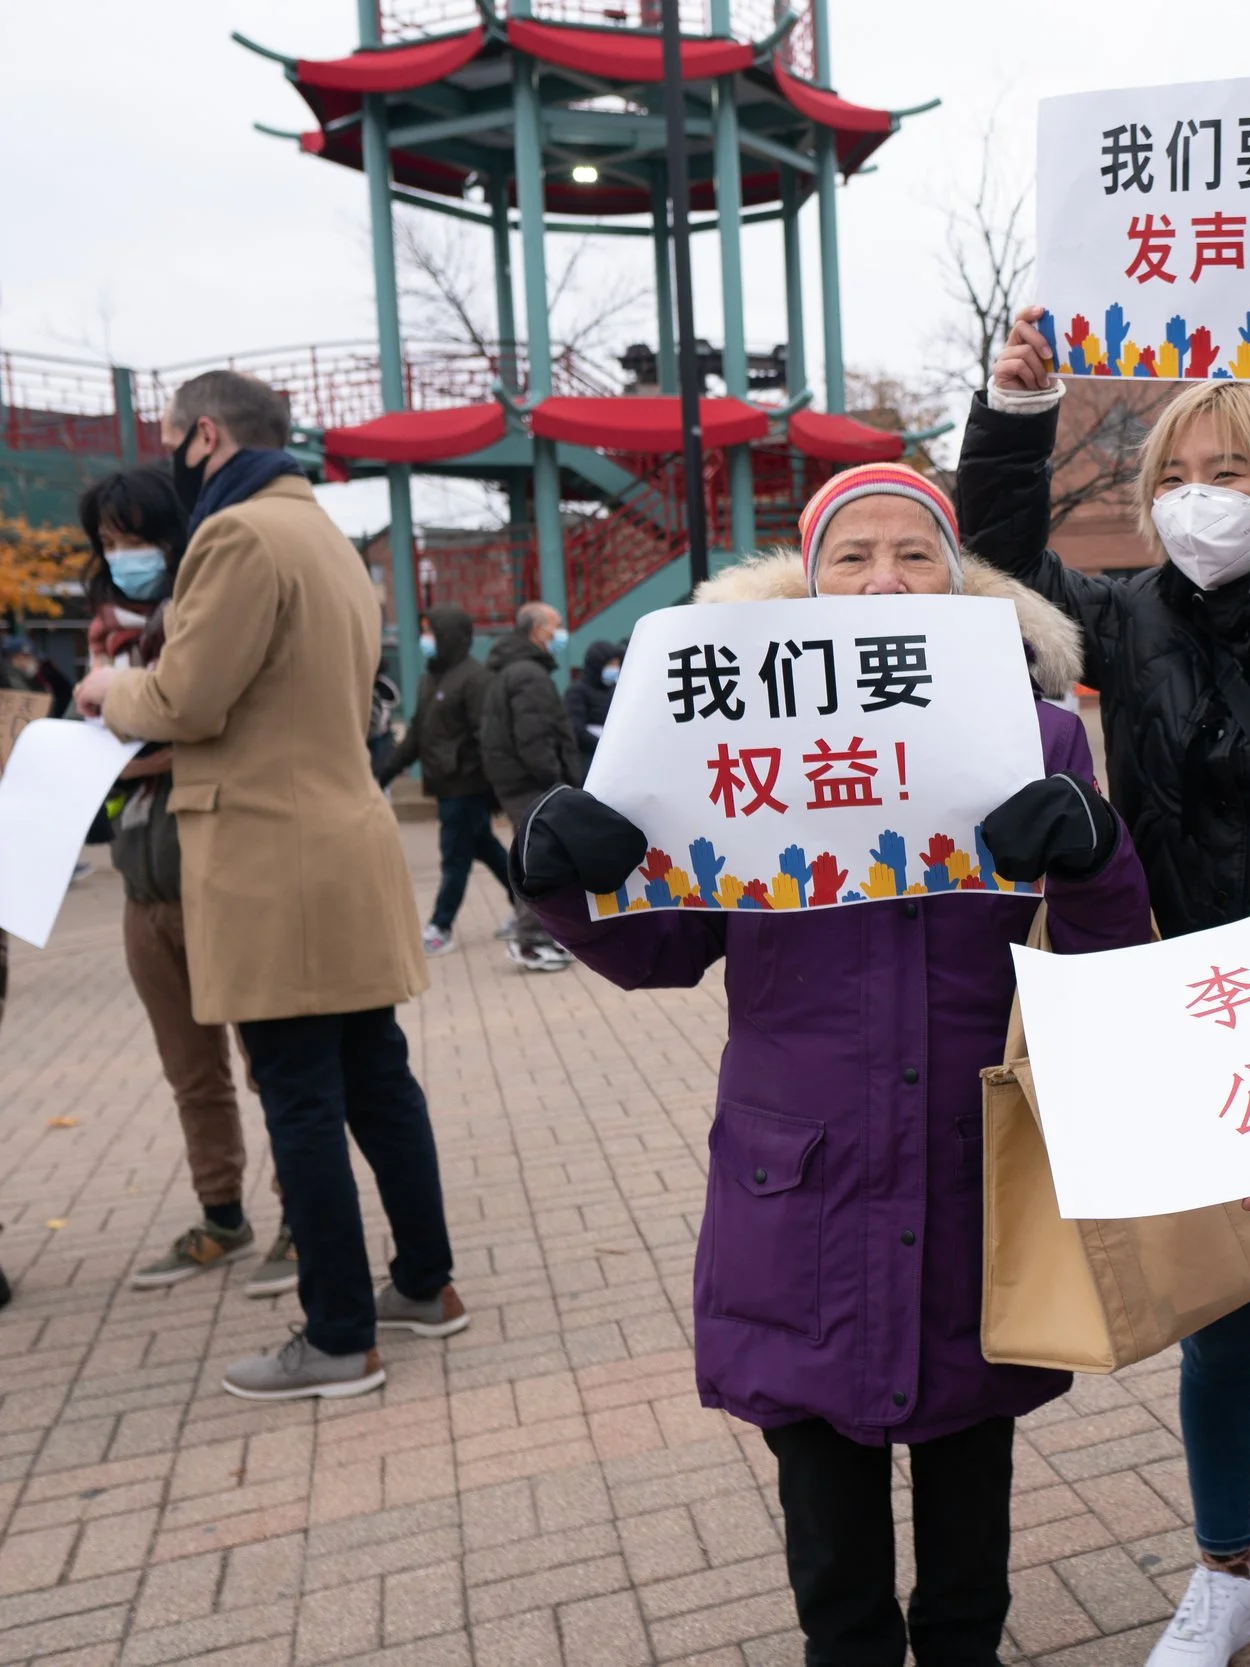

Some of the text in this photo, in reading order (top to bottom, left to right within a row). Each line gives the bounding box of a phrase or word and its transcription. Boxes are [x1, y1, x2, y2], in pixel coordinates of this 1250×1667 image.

[667, 634, 933, 723] 我们要
[706, 736, 909, 818] 权益!
